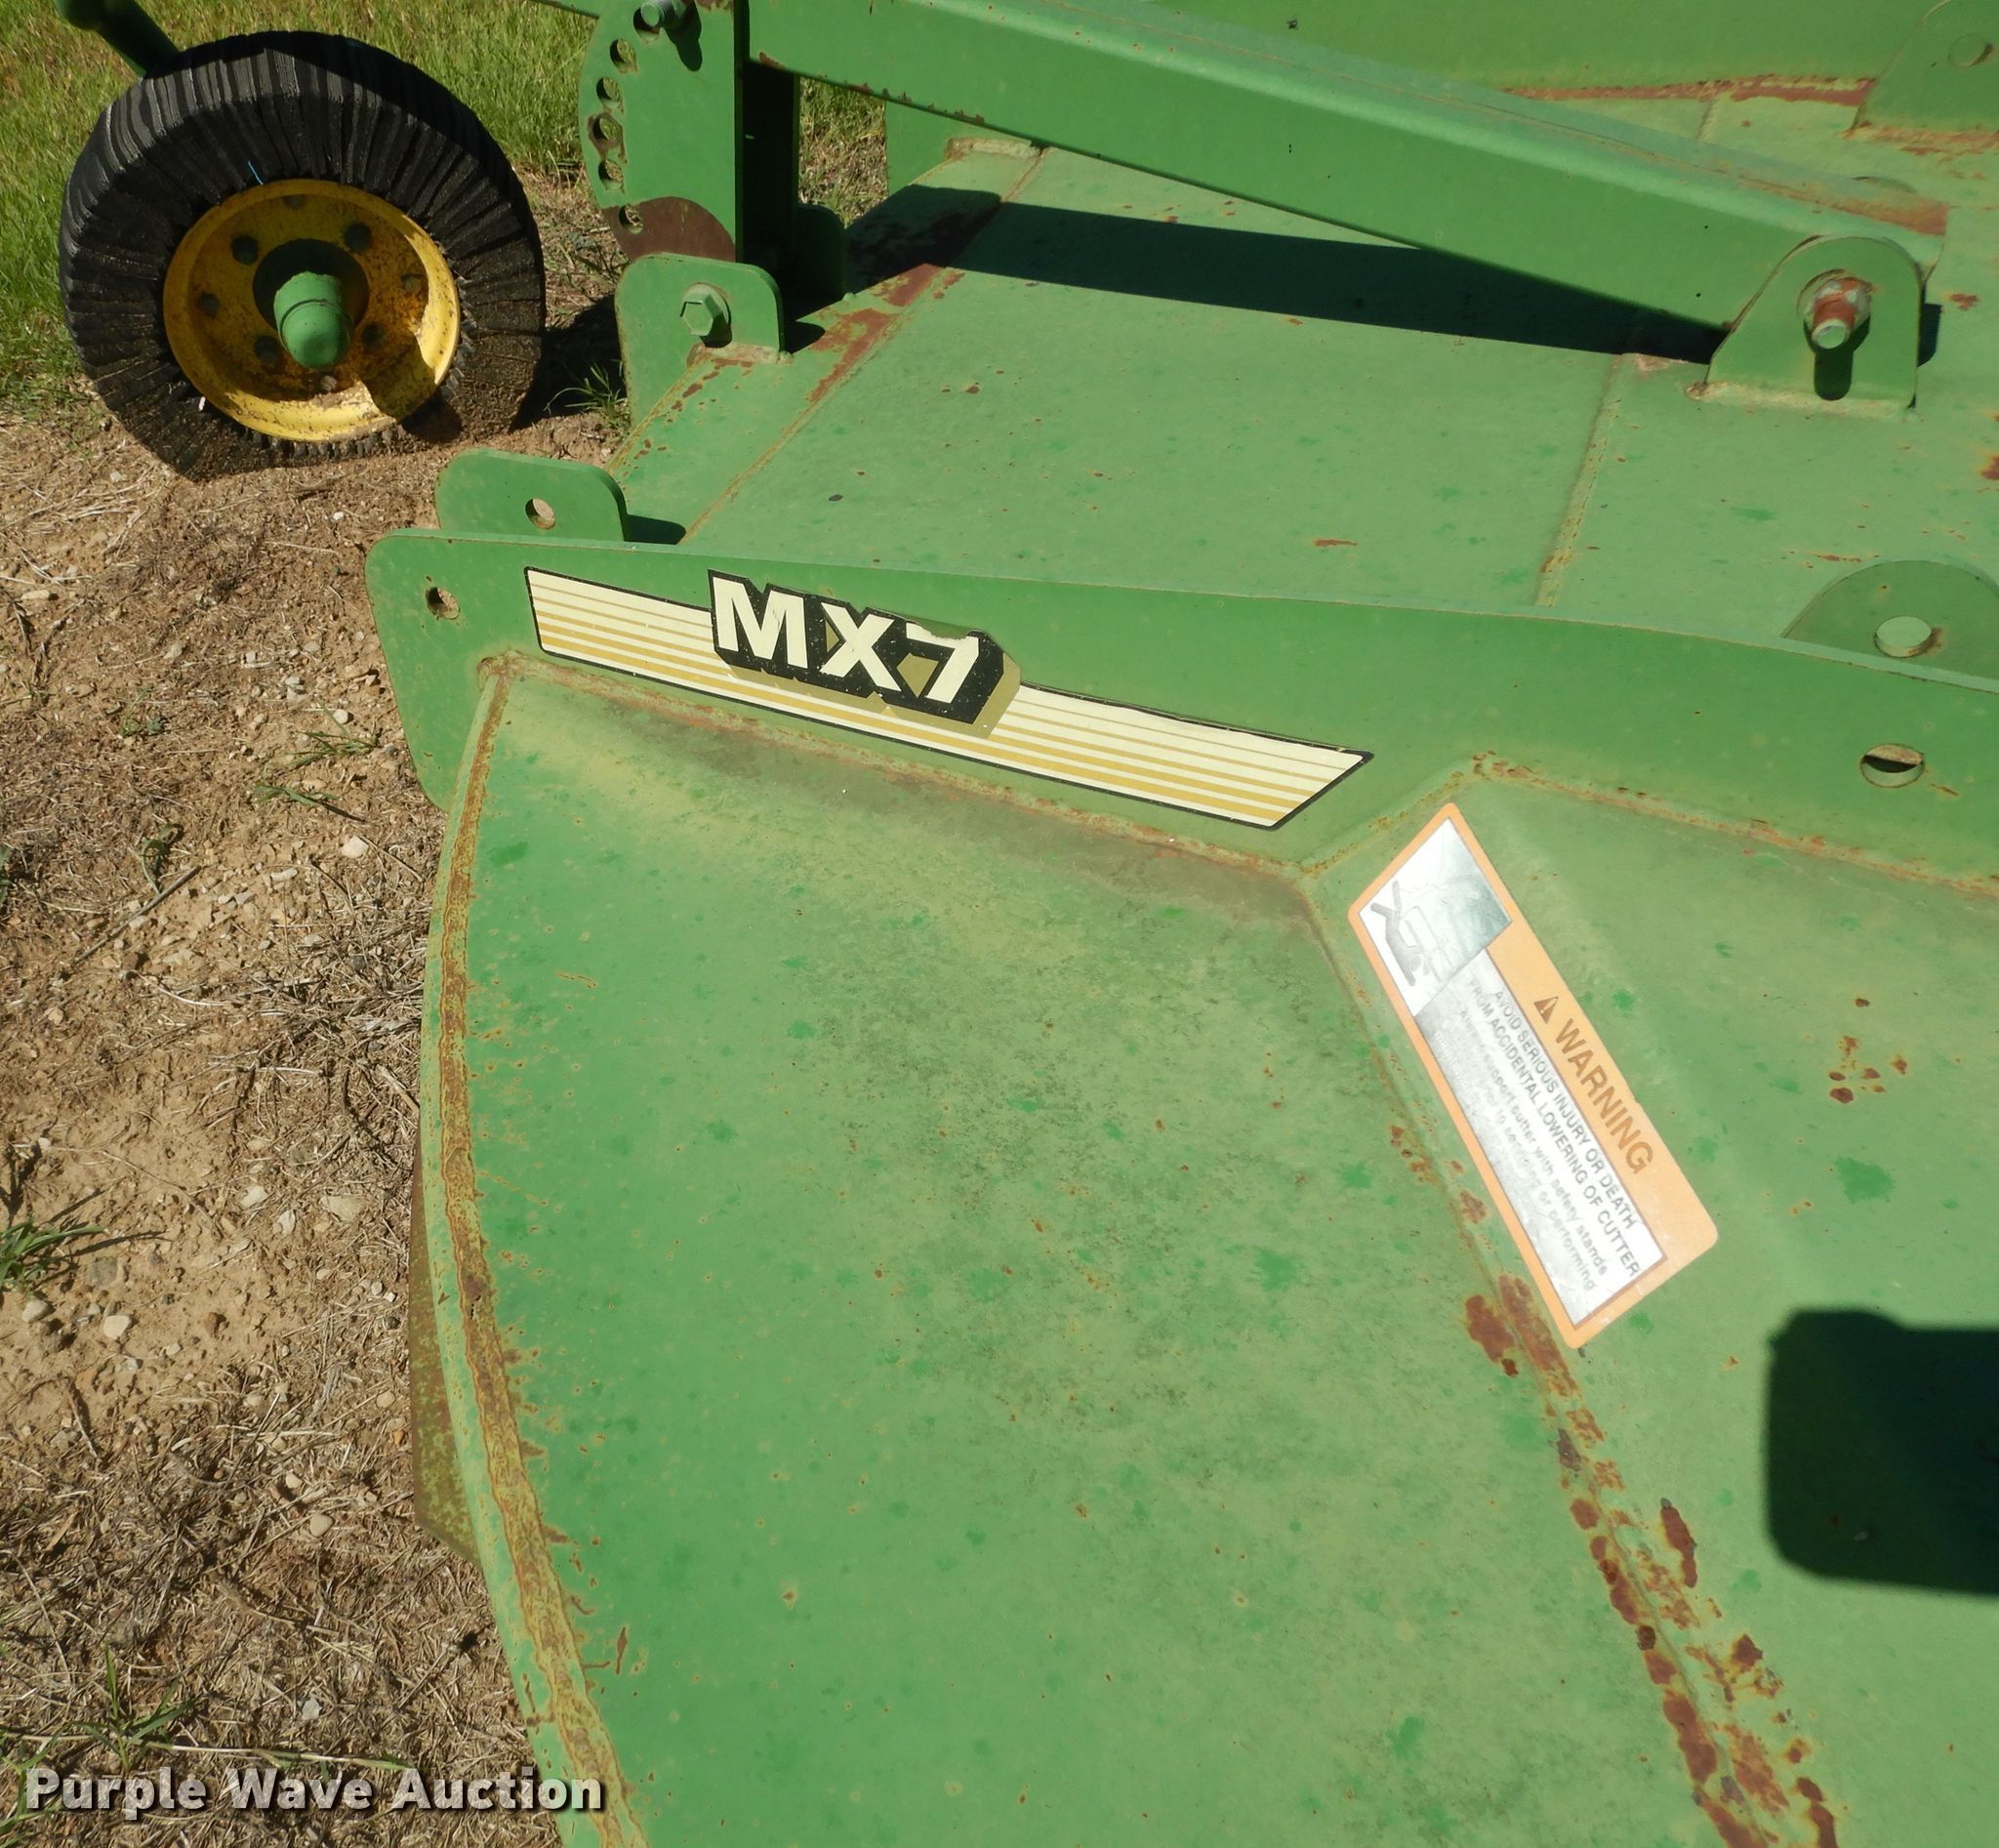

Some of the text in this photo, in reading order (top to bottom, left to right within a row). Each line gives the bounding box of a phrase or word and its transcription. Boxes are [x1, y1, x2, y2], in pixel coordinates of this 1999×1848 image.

[710, 572, 984, 710] MX7
[1469, 976, 1640, 1277] FROM ACCIDENTAL LOWERING OF CUTTER
[1492, 992, 1636, 1229] AVOID SERIOUS INJURY OR DEATH
[1555, 1017, 1653, 1174] WARNING
[1510, 1104, 1536, 1144] cutter
[1534, 1145, 1553, 1177] with
[1551, 1177, 1579, 1222] safety
[1575, 1223, 1608, 1276] stands
[1537, 1189, 1552, 1208] or
[1547, 1208, 1596, 1293] performing
